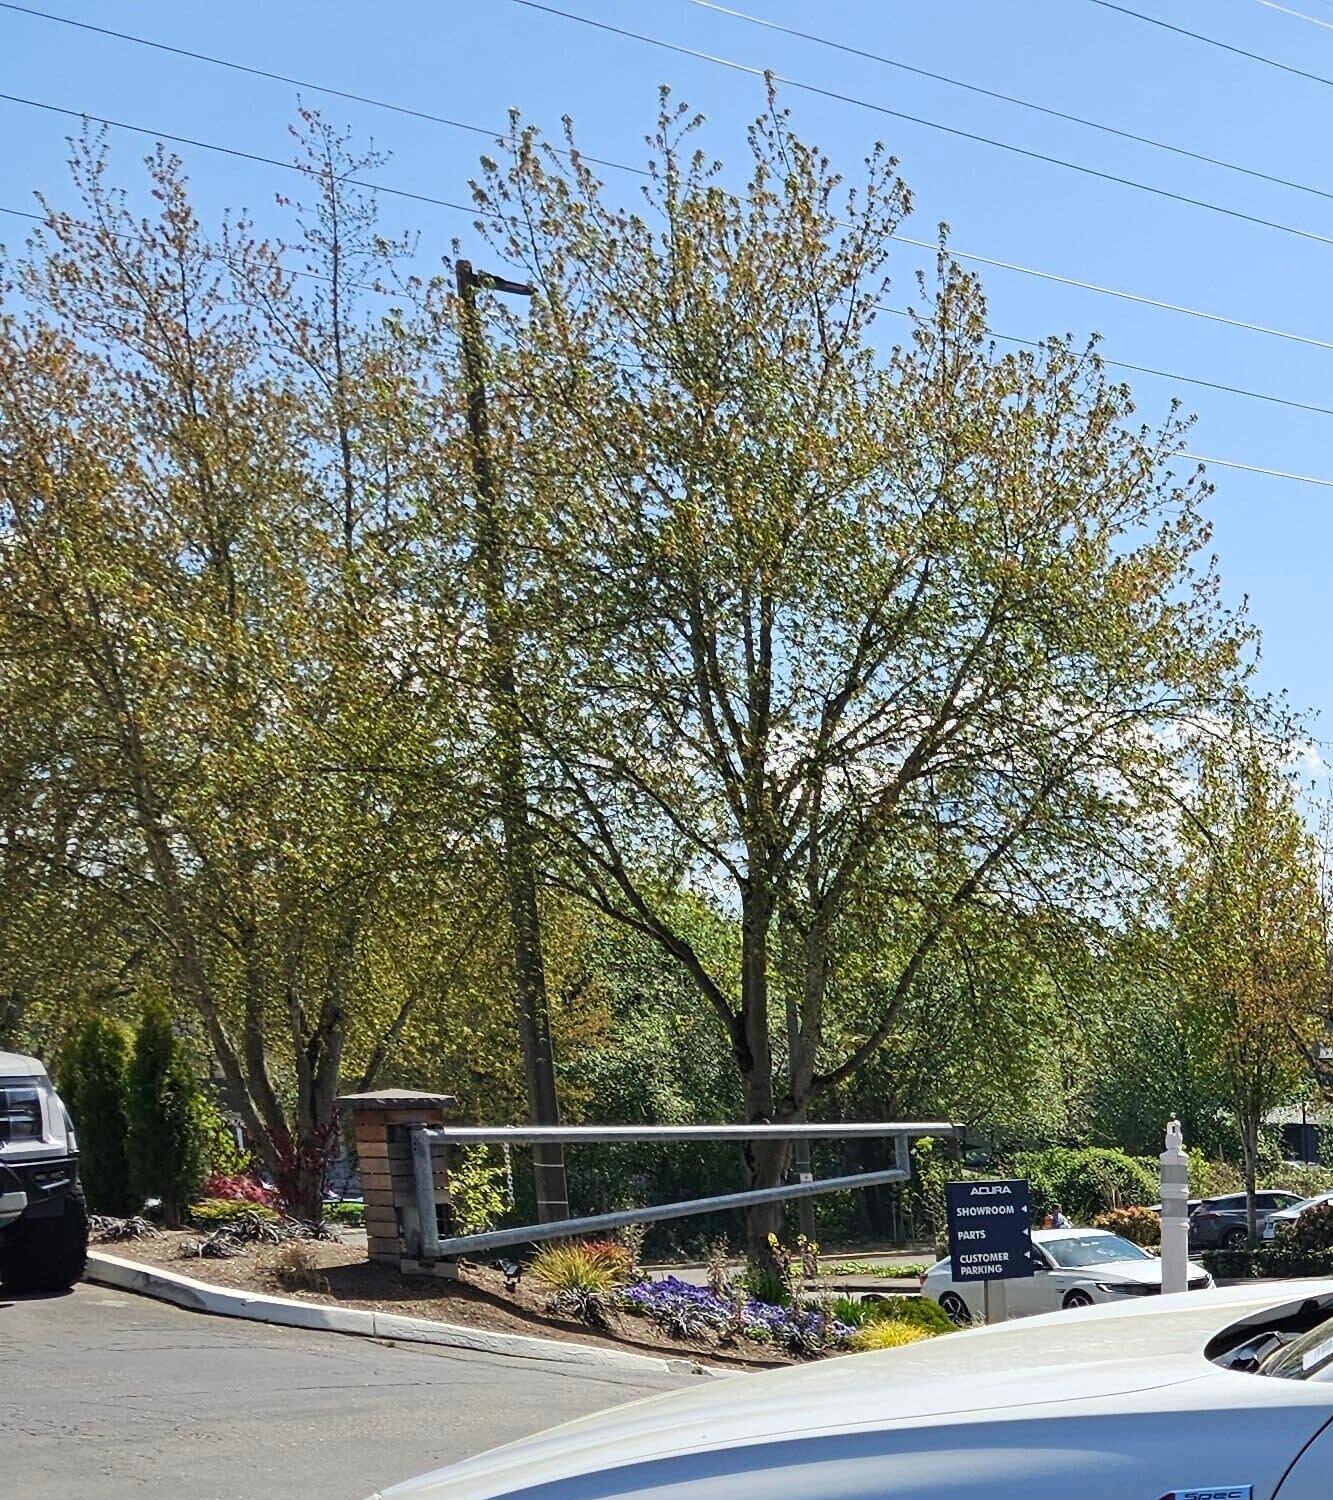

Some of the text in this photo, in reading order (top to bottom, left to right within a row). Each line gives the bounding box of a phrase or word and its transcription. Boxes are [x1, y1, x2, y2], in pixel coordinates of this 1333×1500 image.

[970, 1185, 1012, 1196] ACURA
[956, 1205, 1015, 1217] SHOWROOM
[957, 1230, 986, 1241] PARTS
[960, 1252, 1010, 1264] CUSTOMER
[960, 1264, 1003, 1276] PARKING
